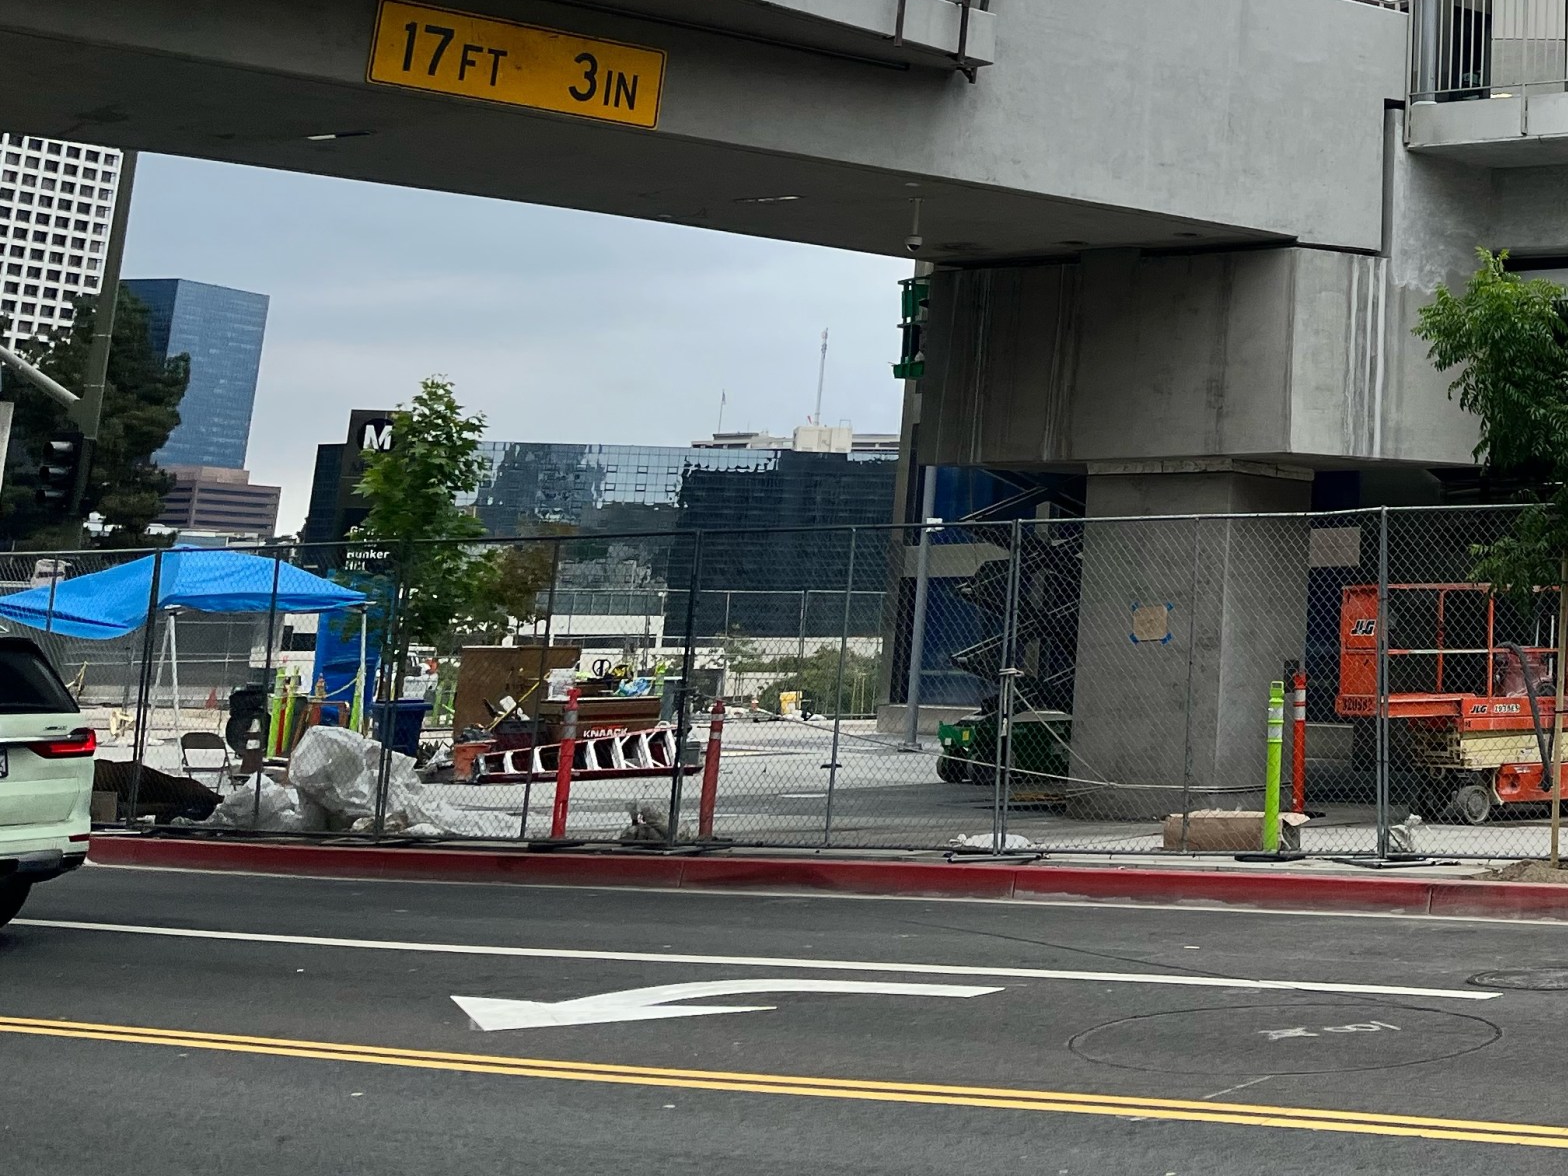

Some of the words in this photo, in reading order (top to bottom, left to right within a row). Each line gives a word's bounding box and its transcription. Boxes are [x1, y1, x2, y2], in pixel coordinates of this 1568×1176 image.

[363, 424, 393, 451] M
[1350, 620, 1376, 636] JLG
[1470, 705, 1488, 714] JLG
[583, 728, 628, 738] KNAACK
